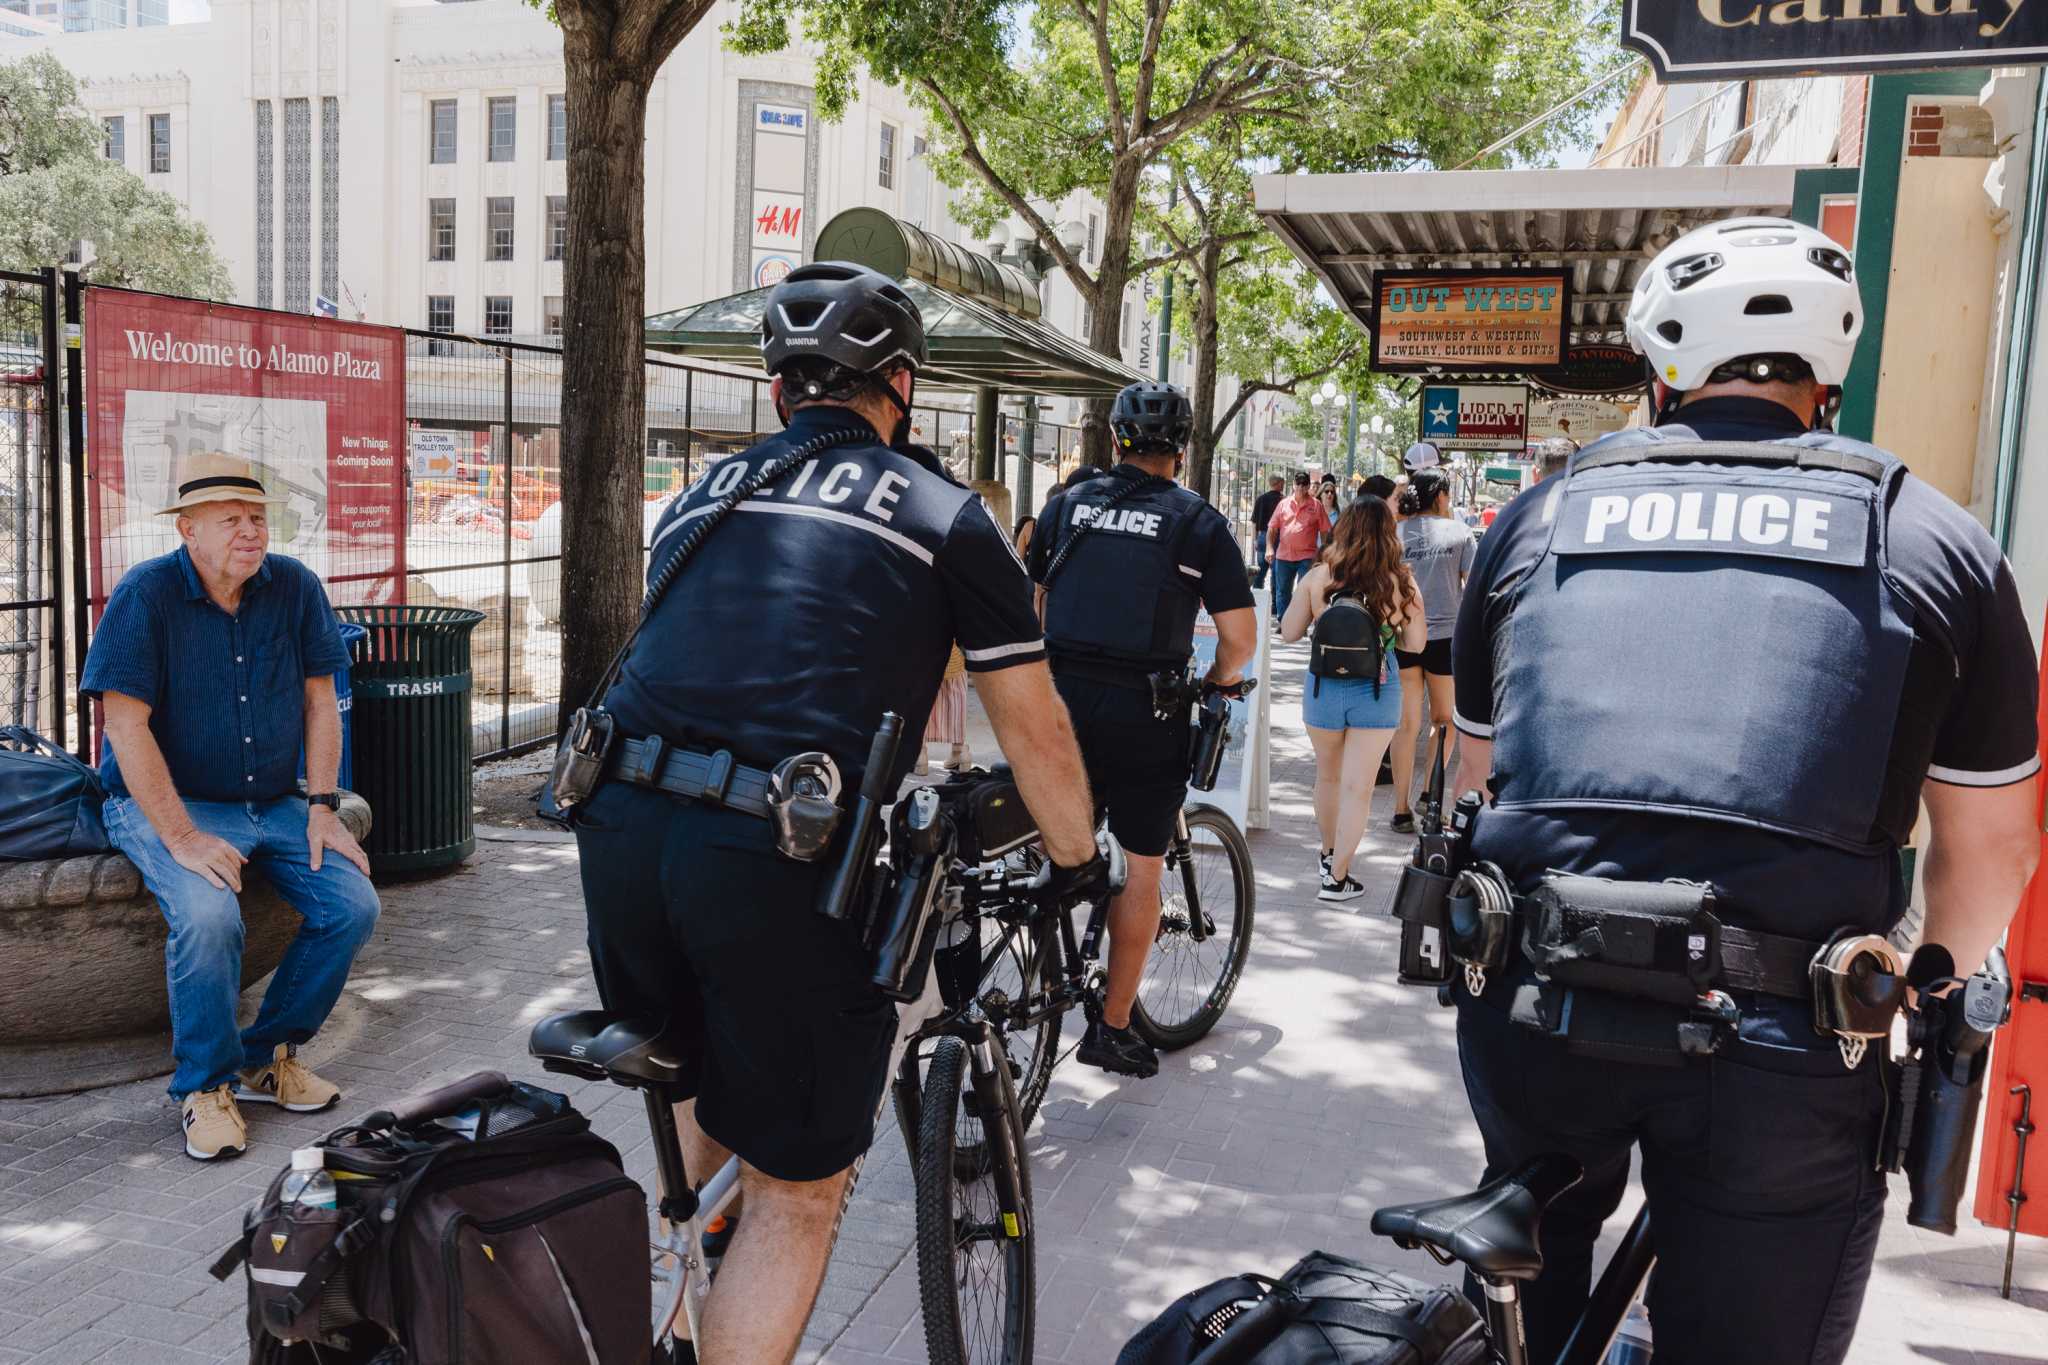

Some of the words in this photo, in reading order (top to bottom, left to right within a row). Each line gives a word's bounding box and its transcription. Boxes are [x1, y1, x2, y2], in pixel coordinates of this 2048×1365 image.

[757, 205, 801, 237] H&M
[1389, 287, 1450, 313] OUT
[1463, 287, 1557, 312] WEST
[785, 337, 819, 346] QUANTUM
[1399, 330, 1466, 341] SOUTHWEST
[1471, 330, 1480, 341] &
[1485, 330, 1542, 341] WESTERN
[1139, 320, 1151, 369] IMAX
[1384, 345, 1441, 357] JEWELRY,
[1445, 345, 1501, 356] CLOTHING
[1507, 345, 1516, 355] &
[1521, 344, 1555, 355] GIFTS
[124, 329, 233, 367] Welcome
[239, 343, 261, 369] to
[265, 344, 329, 375] Alamo
[332, 351, 382, 381] Plaza
[342, 436, 359, 449] New
[361, 436, 389, 451] Things
[438, 444, 455, 452] TOURS
[337, 454, 369, 469] Coming
[370, 455, 394, 467] Soon!
[1071, 503, 1162, 537] POLICE
[1584, 492, 1832, 551] POLICE
[386, 681, 443, 696] TRASH
